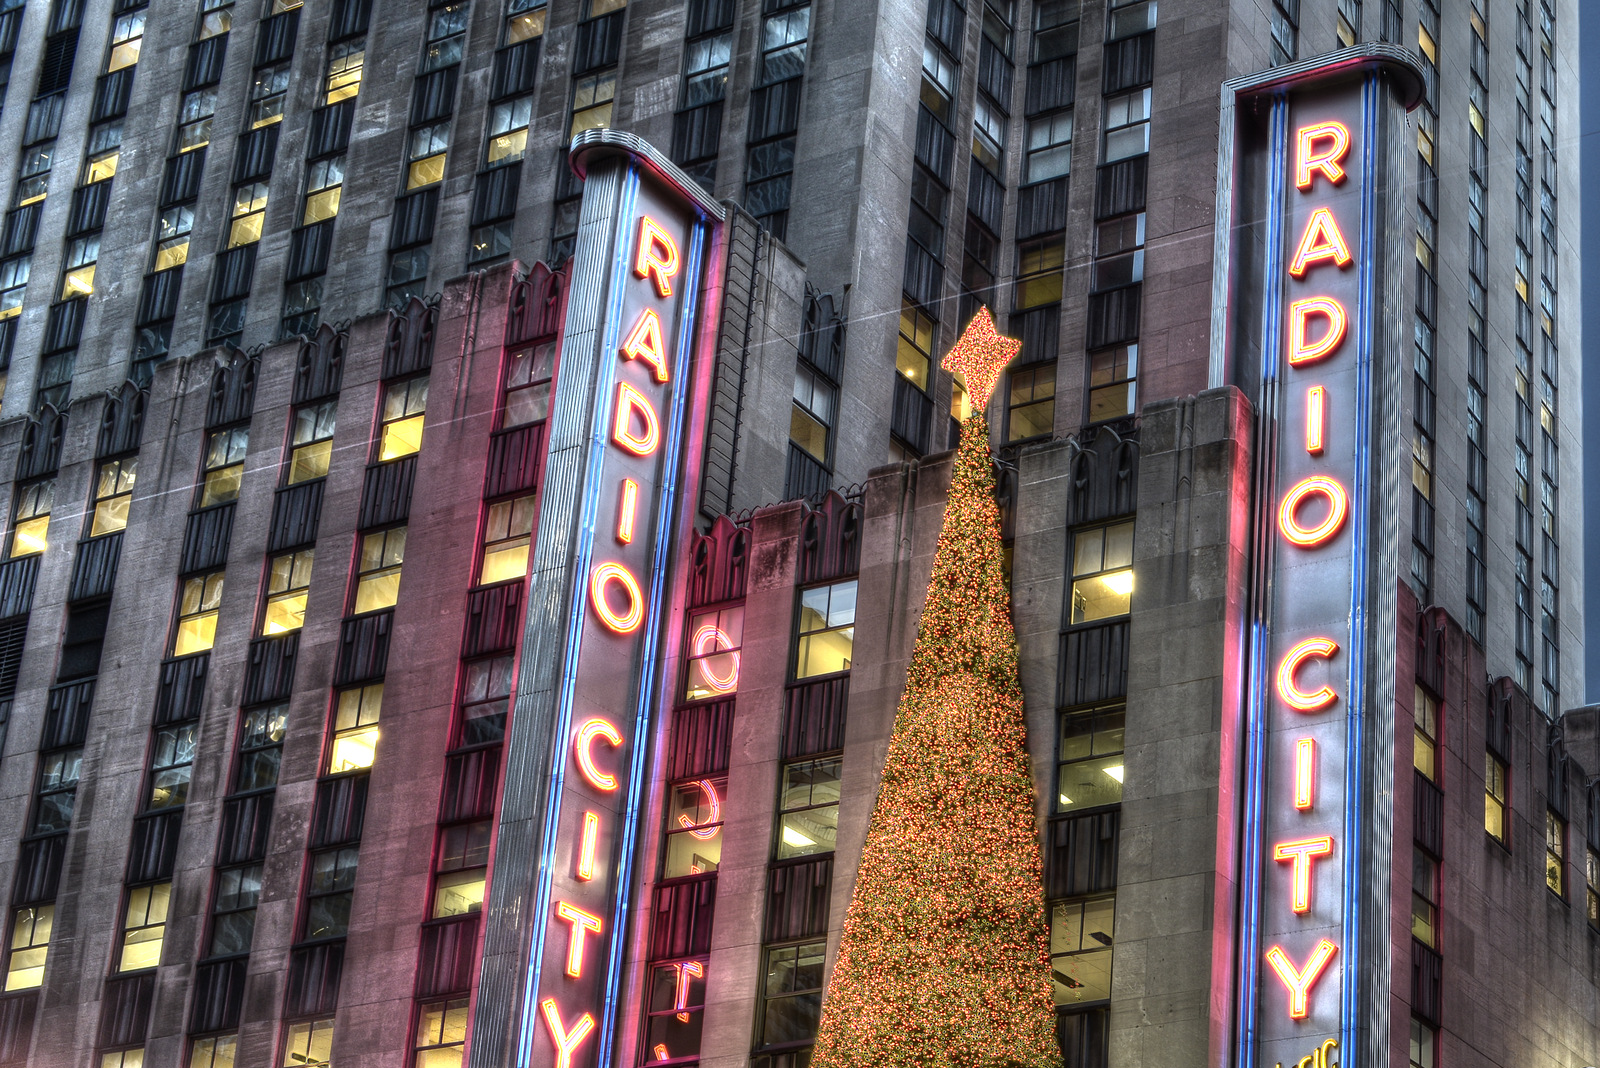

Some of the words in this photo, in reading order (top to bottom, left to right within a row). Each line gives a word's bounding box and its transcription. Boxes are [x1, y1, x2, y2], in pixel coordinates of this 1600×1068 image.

[588, 214, 681, 634] RADIO
[1278, 119, 1352, 547] RADIO
[1265, 636, 1340, 1022] CITY
